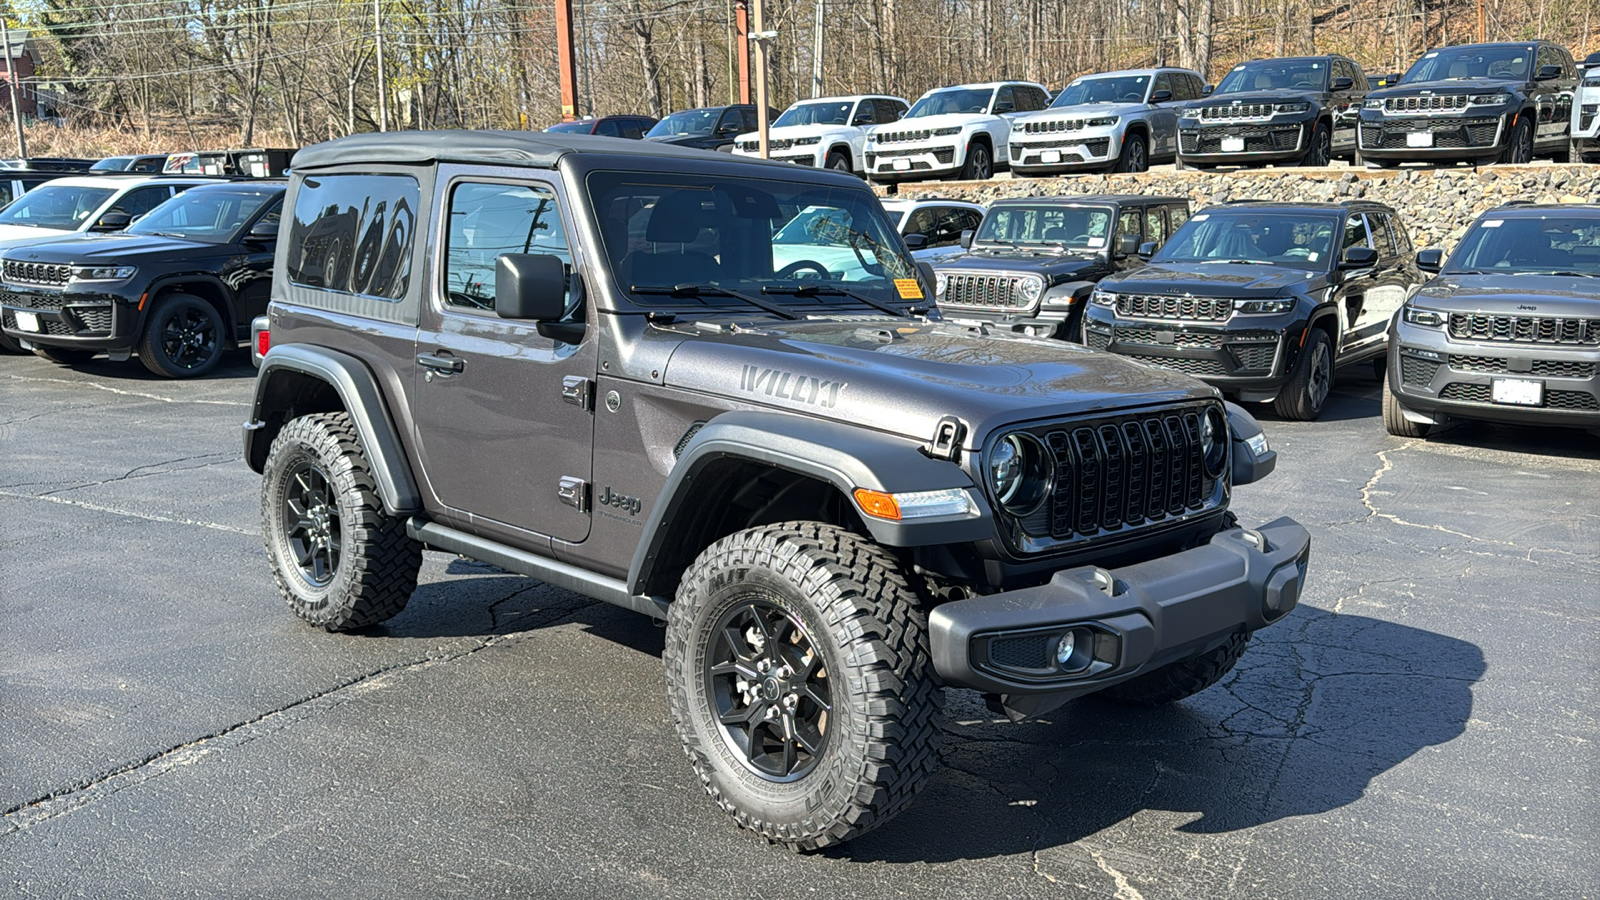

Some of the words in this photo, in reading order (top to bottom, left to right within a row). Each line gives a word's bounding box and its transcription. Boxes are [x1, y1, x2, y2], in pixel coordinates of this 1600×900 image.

[740, 364, 845, 409] WILLYS
[598, 485, 642, 517] Jeep
[708, 567, 750, 596] M/T
